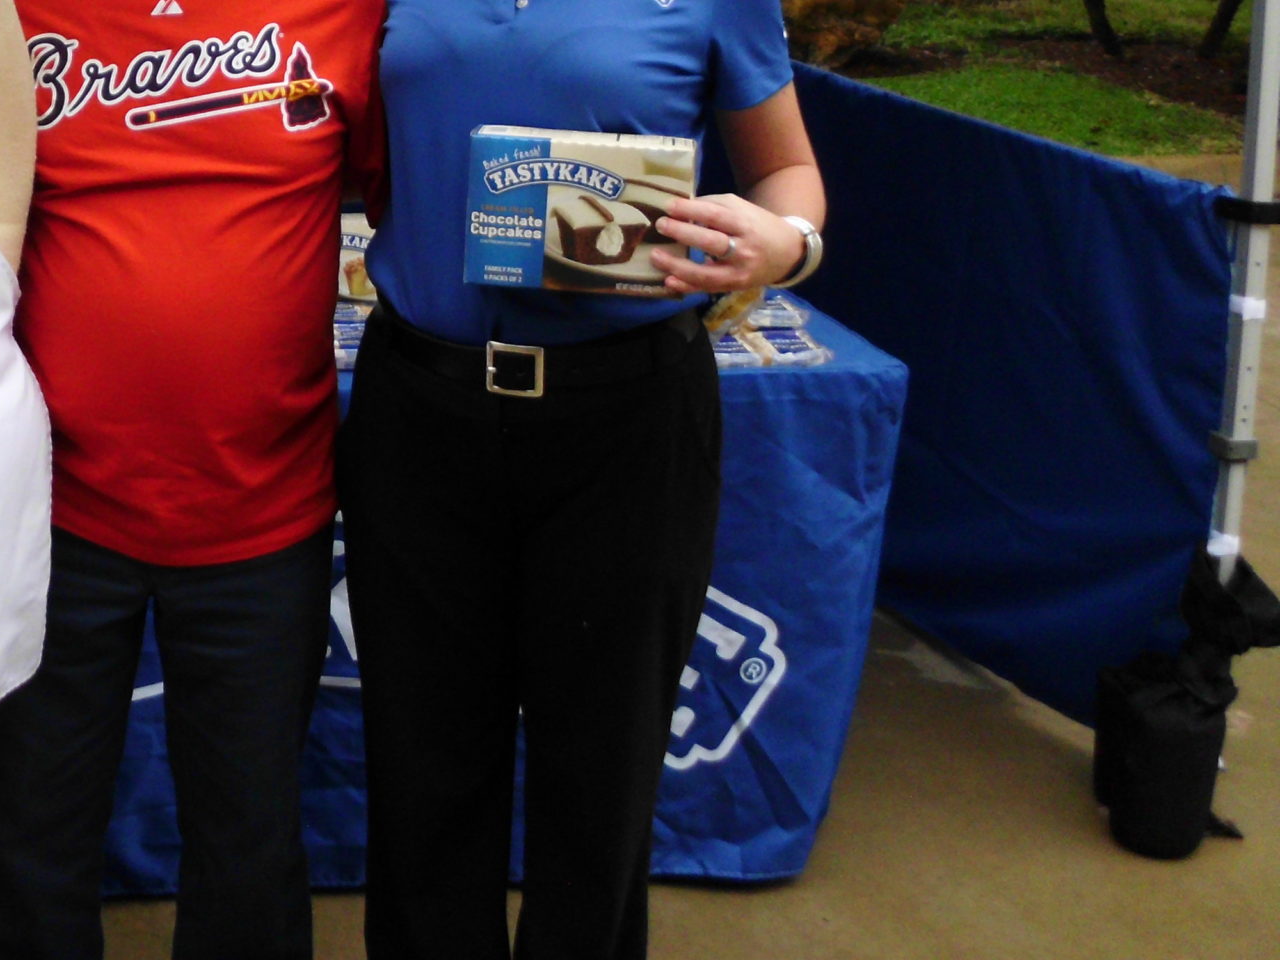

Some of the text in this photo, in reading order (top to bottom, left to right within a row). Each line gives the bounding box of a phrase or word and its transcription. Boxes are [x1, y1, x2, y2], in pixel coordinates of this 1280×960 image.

[26, 22, 279, 130] Braves
[488, 162, 620, 195] TASTYKAKE
[470, 223, 542, 239] Cupcakes
[471, 211, 543, 227] Chocolate
